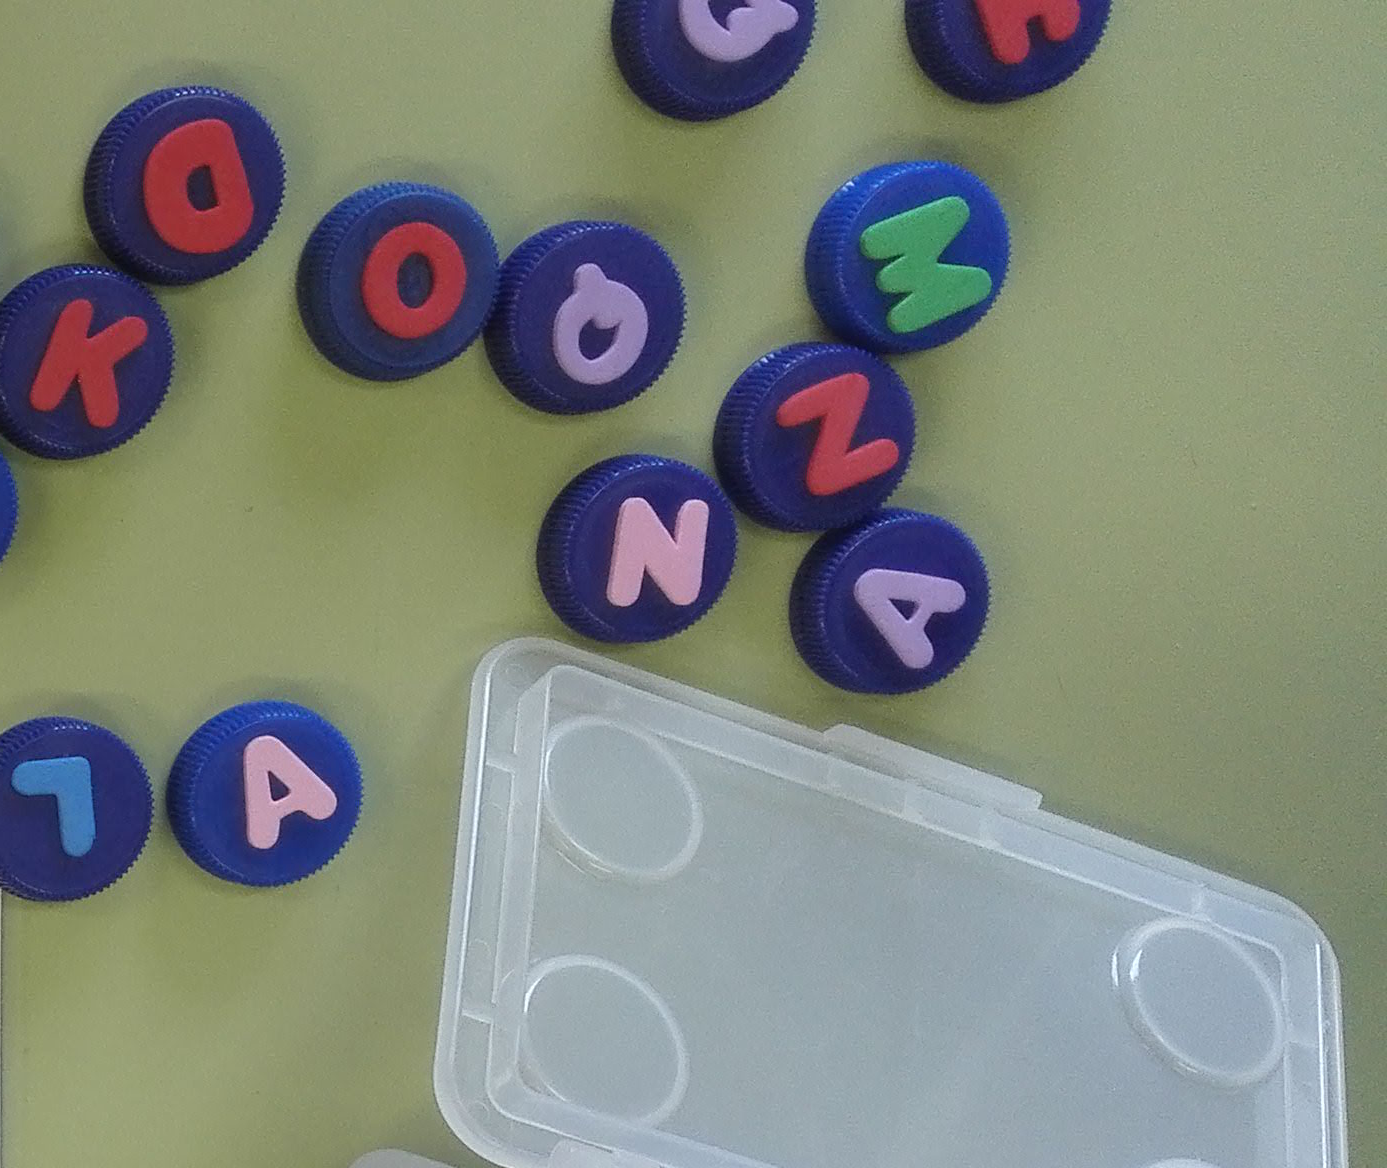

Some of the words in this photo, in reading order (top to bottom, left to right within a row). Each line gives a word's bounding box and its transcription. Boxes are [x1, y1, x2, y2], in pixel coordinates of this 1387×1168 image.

[143, 119, 254, 253] D
[362, 222, 467, 338] O
[861, 196, 992, 332] M
[30, 299, 147, 427] K
[553, 263, 649, 385] Q
[606, 497, 709, 607] N
[854, 569, 965, 668] A
[13, 757, 95, 855] L
[243, 735, 337, 849] A
